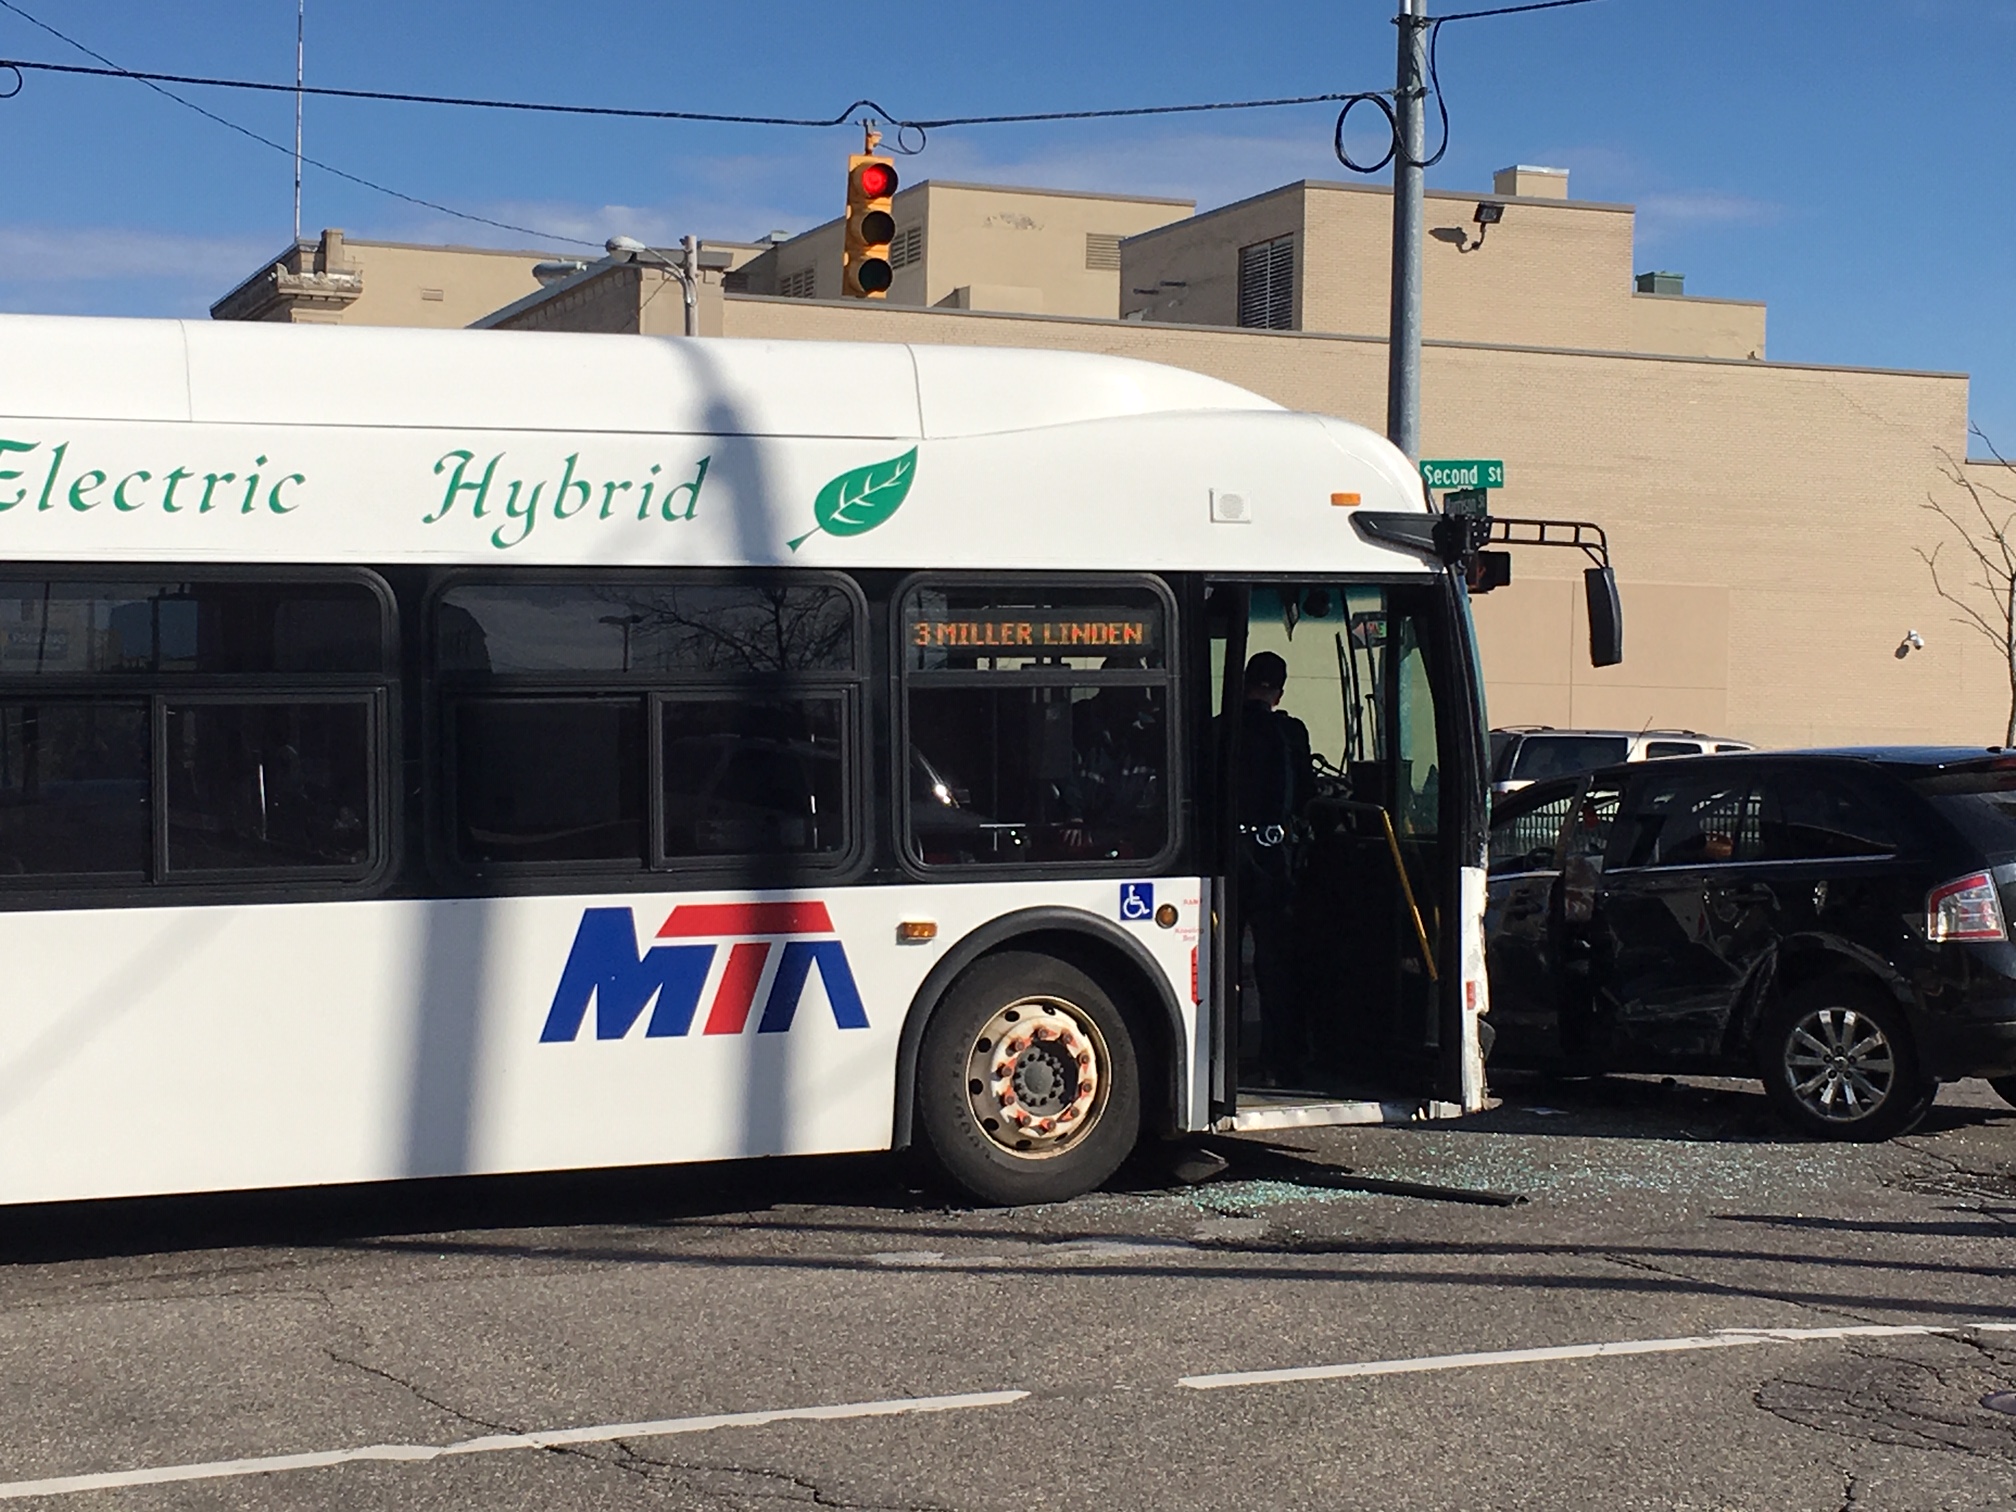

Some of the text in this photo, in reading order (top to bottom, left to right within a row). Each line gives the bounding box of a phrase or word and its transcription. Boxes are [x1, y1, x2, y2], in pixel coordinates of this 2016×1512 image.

[422, 449, 712, 549] Hybrid
[1423, 464, 1502, 485] Second St
[914, 622, 1143, 645] 3 MILLER LINDEN
[539, 901, 870, 1043] MTA
